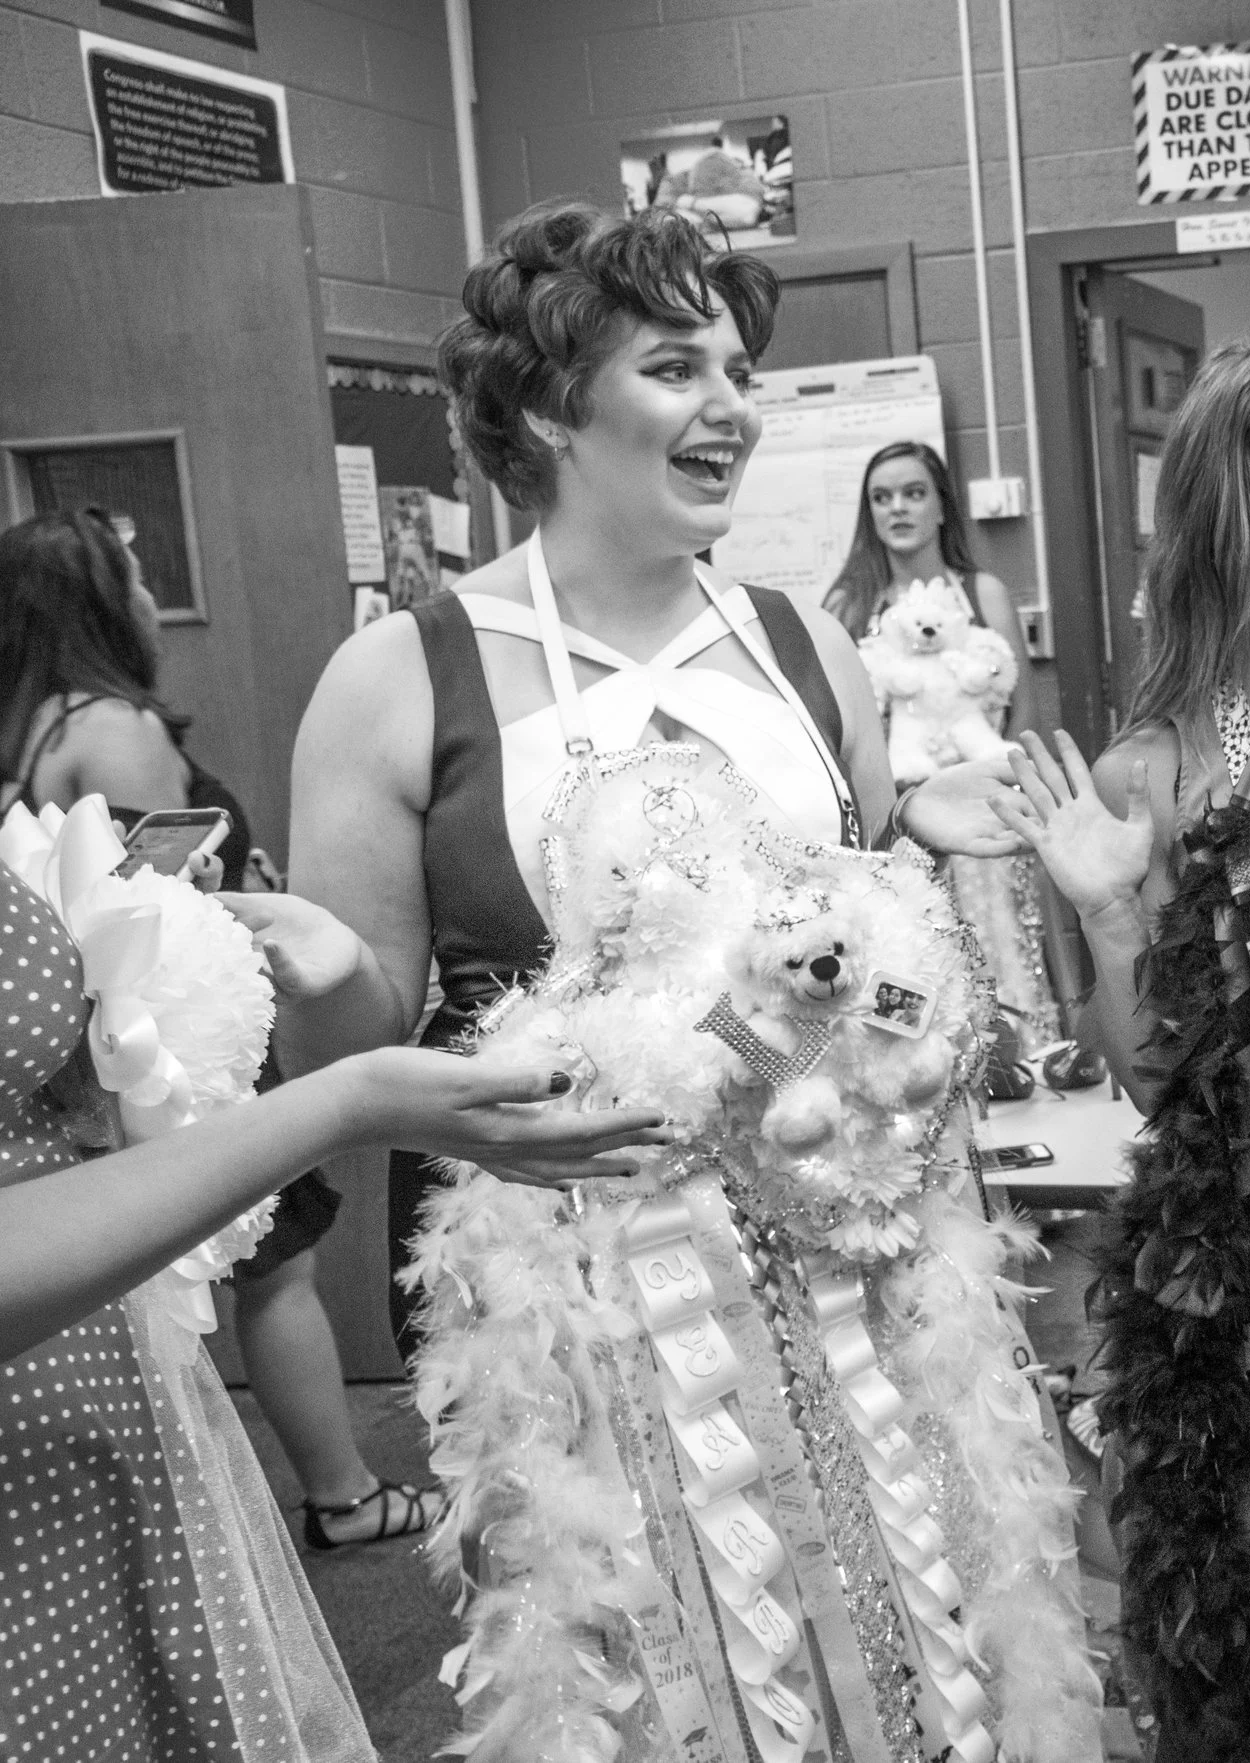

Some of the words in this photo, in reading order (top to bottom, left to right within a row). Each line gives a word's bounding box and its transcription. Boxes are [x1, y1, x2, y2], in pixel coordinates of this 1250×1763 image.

[1165, 88, 1216, 112] DUE
[1159, 113, 1207, 137] ARE
[1162, 135, 1236, 160] THAN
[641, 1632, 681, 1652] Class
[657, 1646, 672, 1665] of
[655, 1662, 694, 1688] 2018
